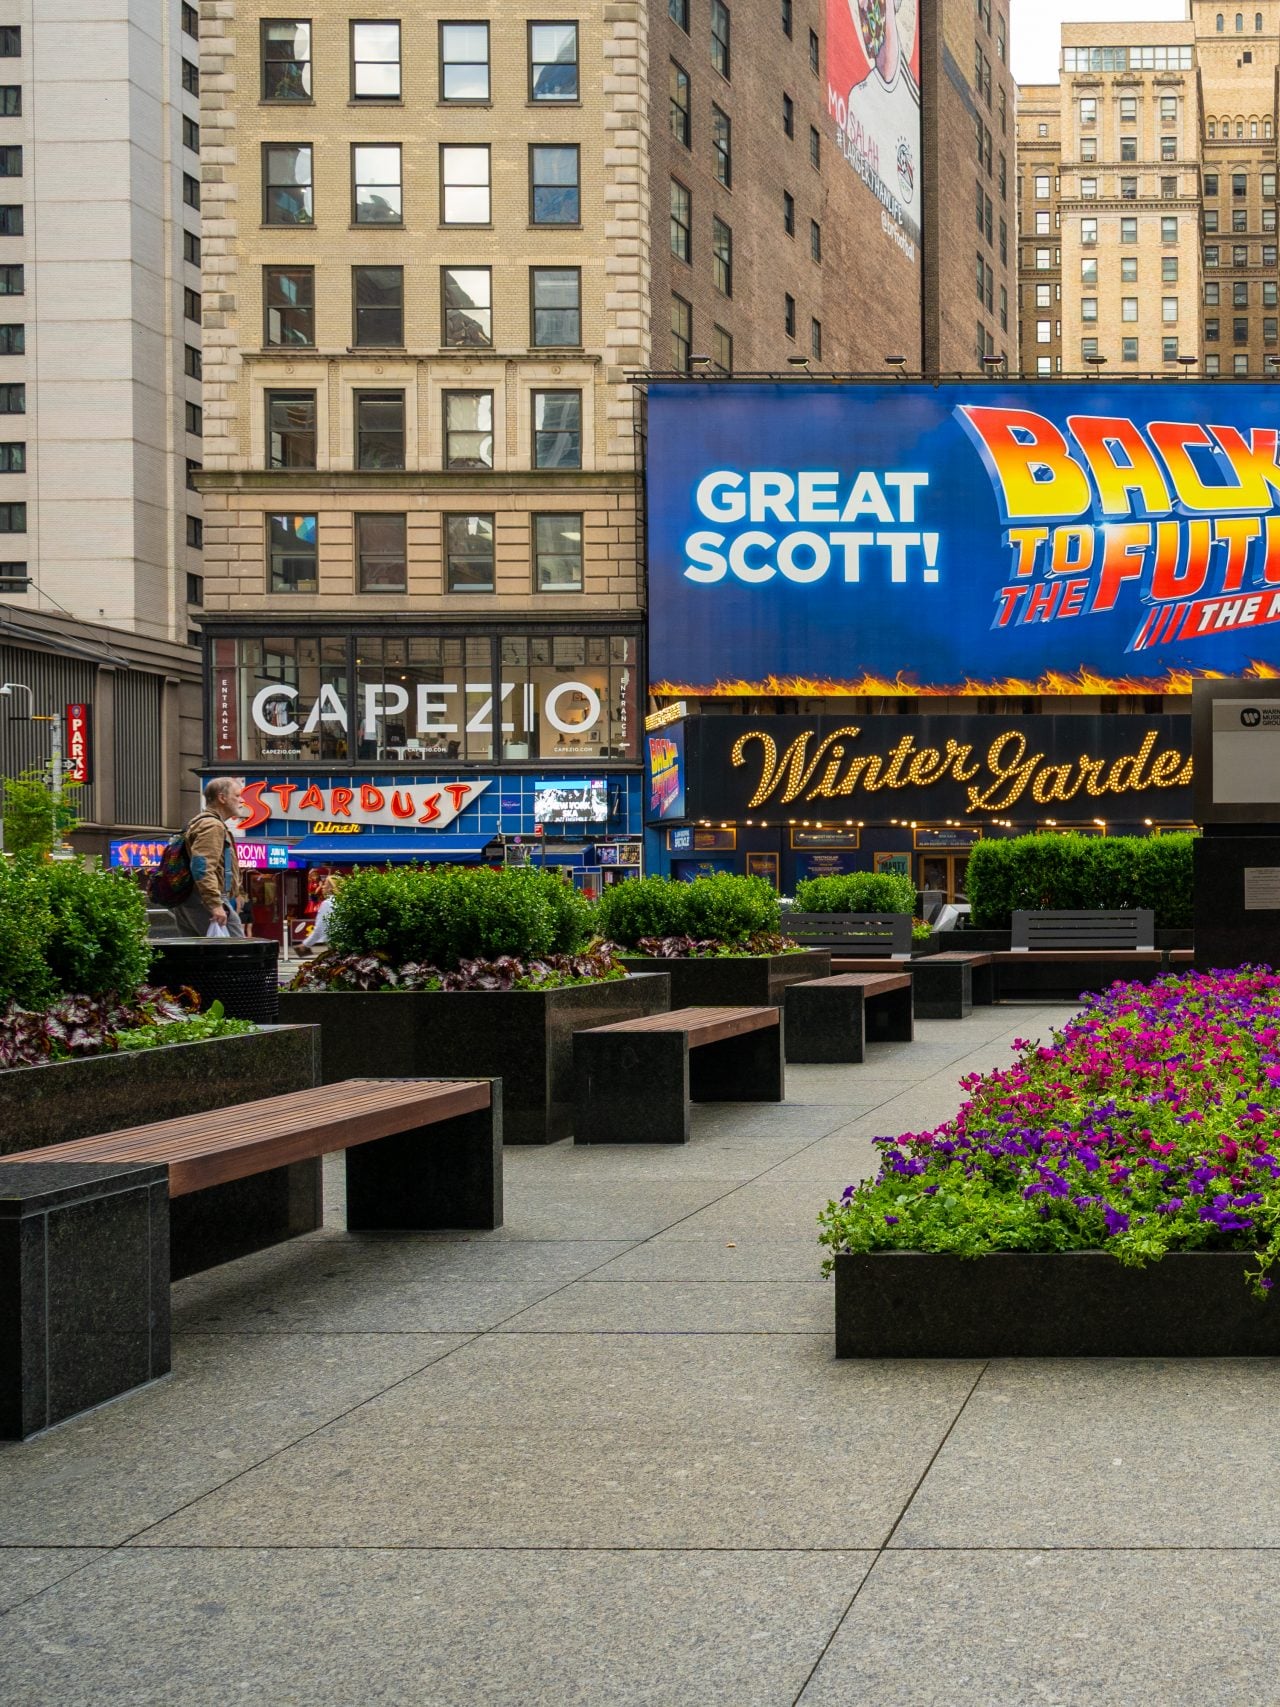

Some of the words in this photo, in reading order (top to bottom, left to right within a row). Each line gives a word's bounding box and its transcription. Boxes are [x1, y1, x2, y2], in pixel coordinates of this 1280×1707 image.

[848, 111, 880, 173] SALAH
[696, 471, 929, 523] GREAT
[684, 531, 939, 583] SCOTT!
[1003, 524, 1095, 579] TO
[990, 577, 1090, 631] THE
[1197, 600, 1264, 633] THE
[221, 679, 230, 740] ENTRANCE
[252, 682, 601, 736] CAPEZIO
[619, 677, 628, 738] ENTRANCE
[731, 727, 980, 808] Winter
[237, 781, 471, 829] STARDUST
[313, 821, 361, 834] Diner
[562, 809, 579, 817] SKA
[118, 842, 166, 863] STARD
[237, 844, 266, 860] ROLYN
